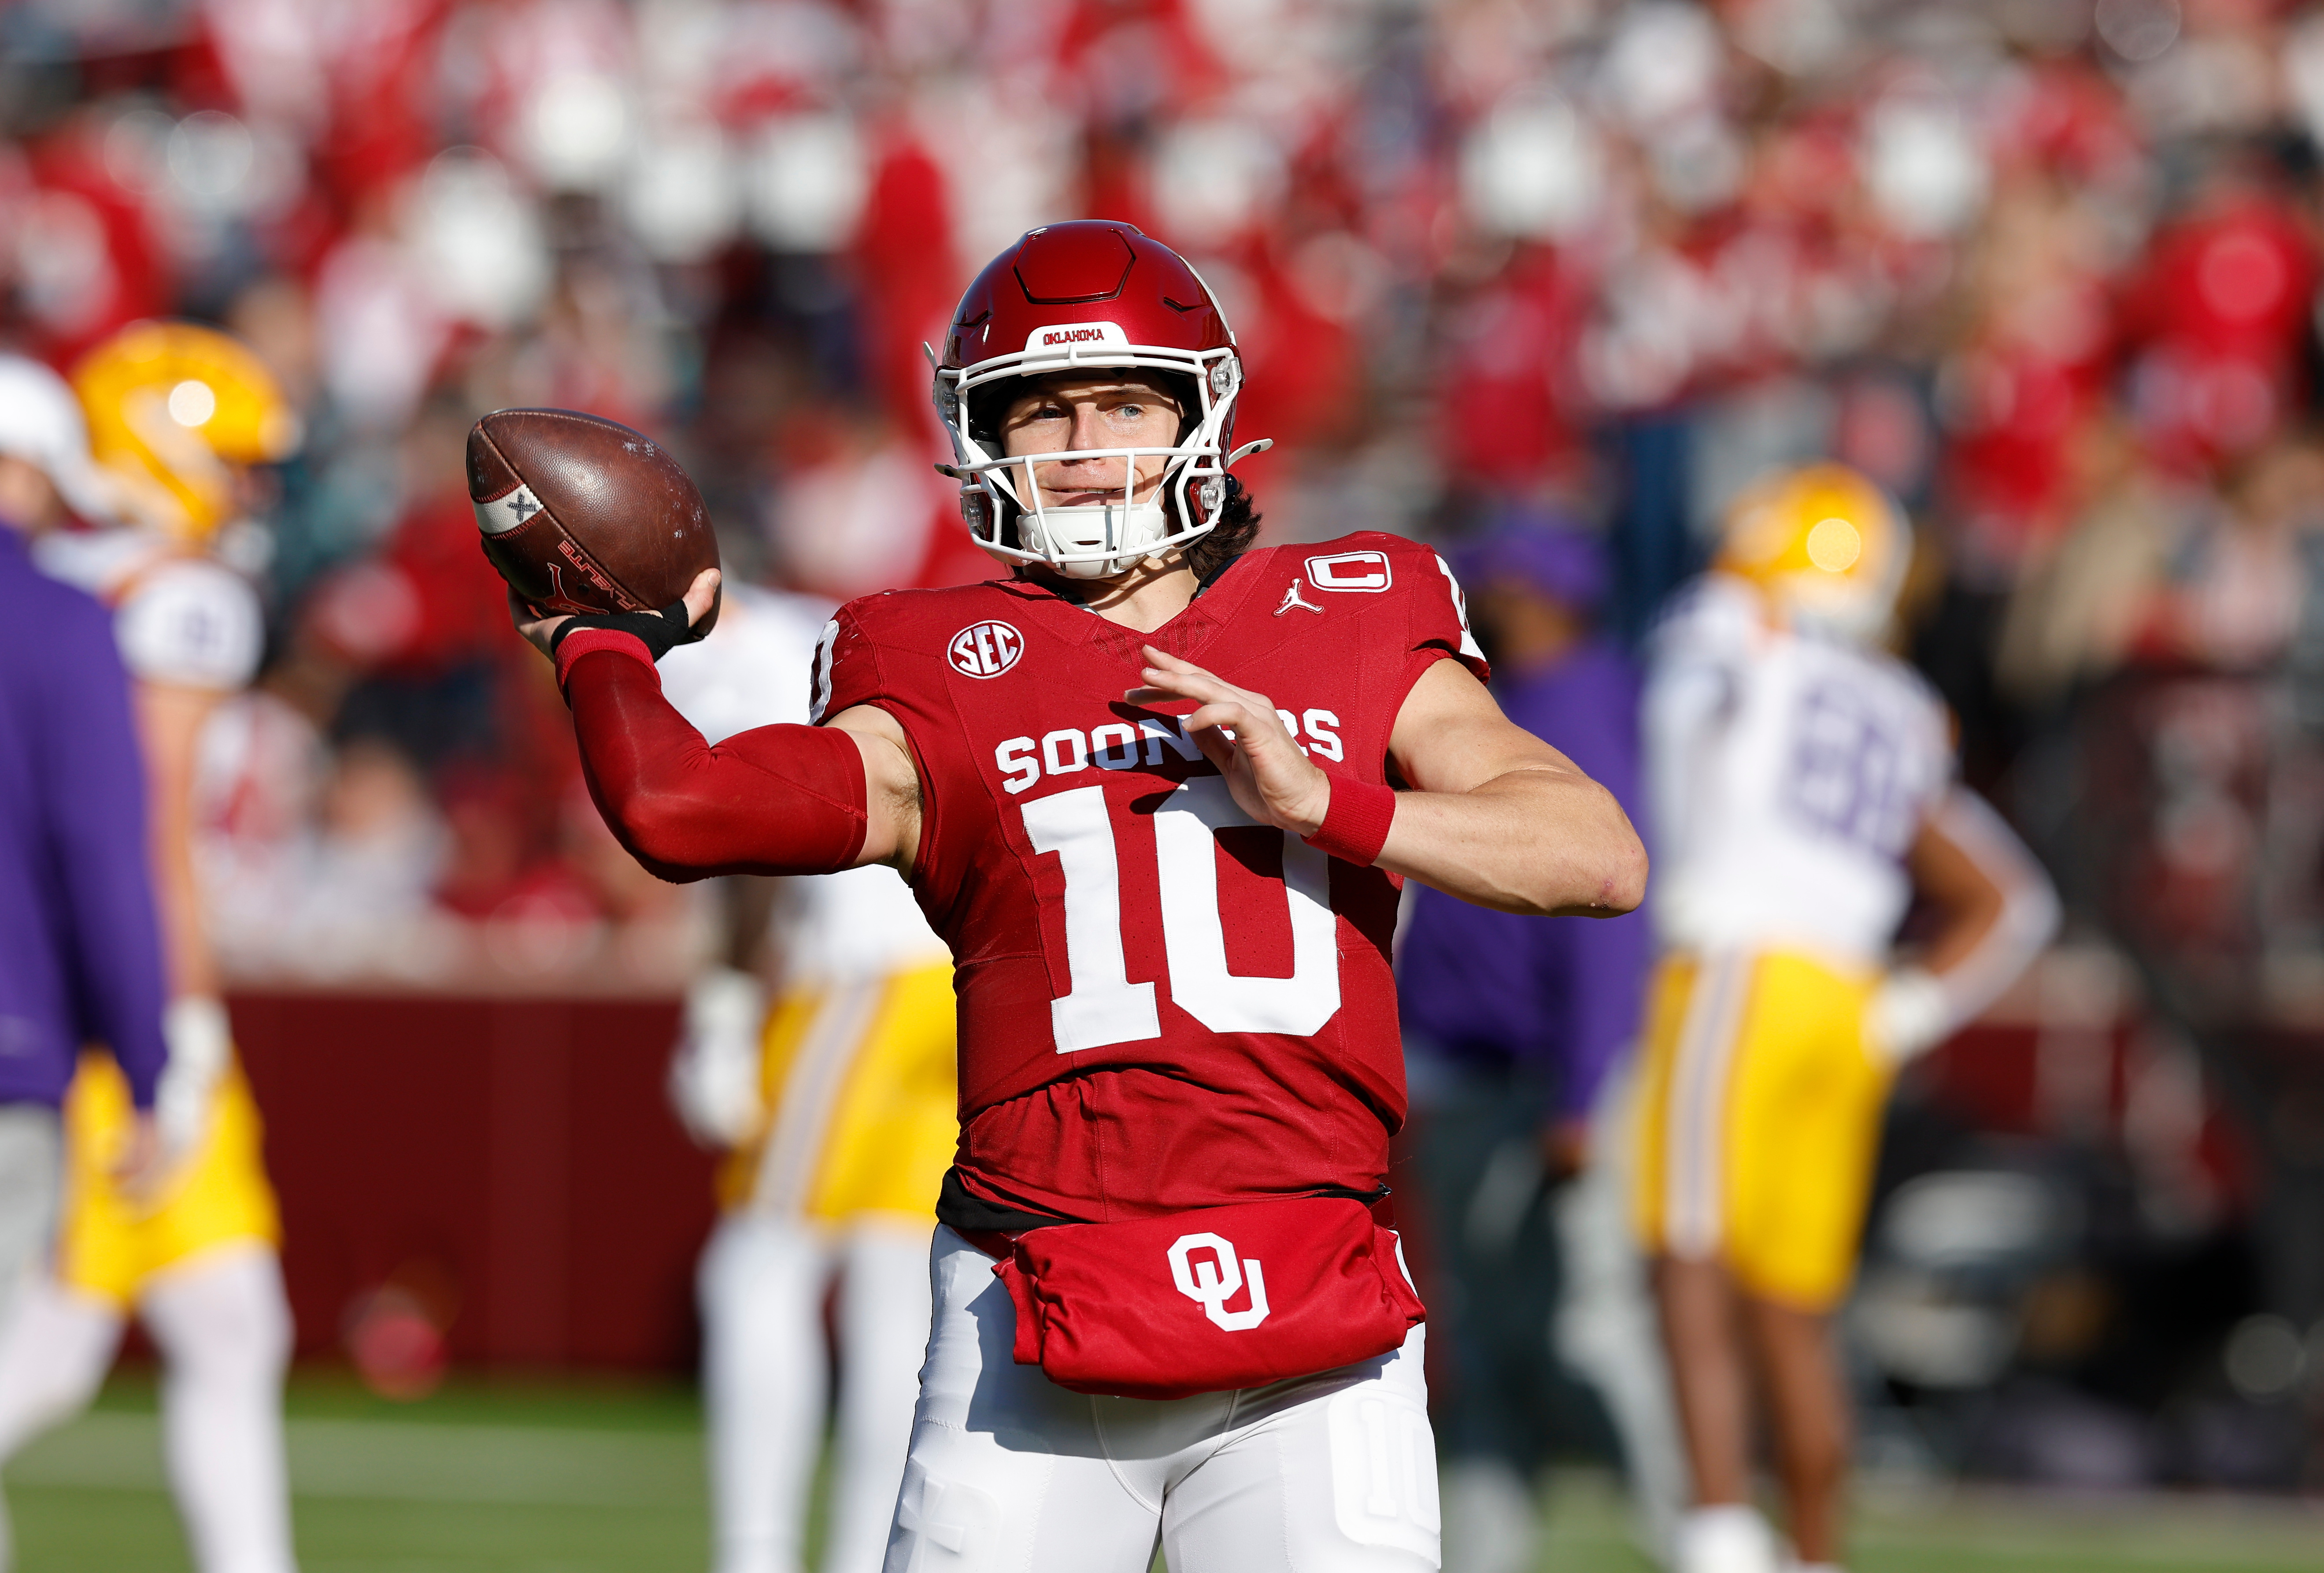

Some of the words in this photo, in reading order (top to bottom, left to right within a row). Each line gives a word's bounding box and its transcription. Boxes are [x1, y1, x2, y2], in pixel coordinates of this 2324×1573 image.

[1044, 329, 1104, 346] OKLAHOMA
[1311, 553, 1385, 587] C
[954, 624, 1018, 674] SEC
[995, 709, 1344, 794] SOONS
[1020, 775, 1342, 1054] 10
[1167, 1232, 1270, 1332] OU
